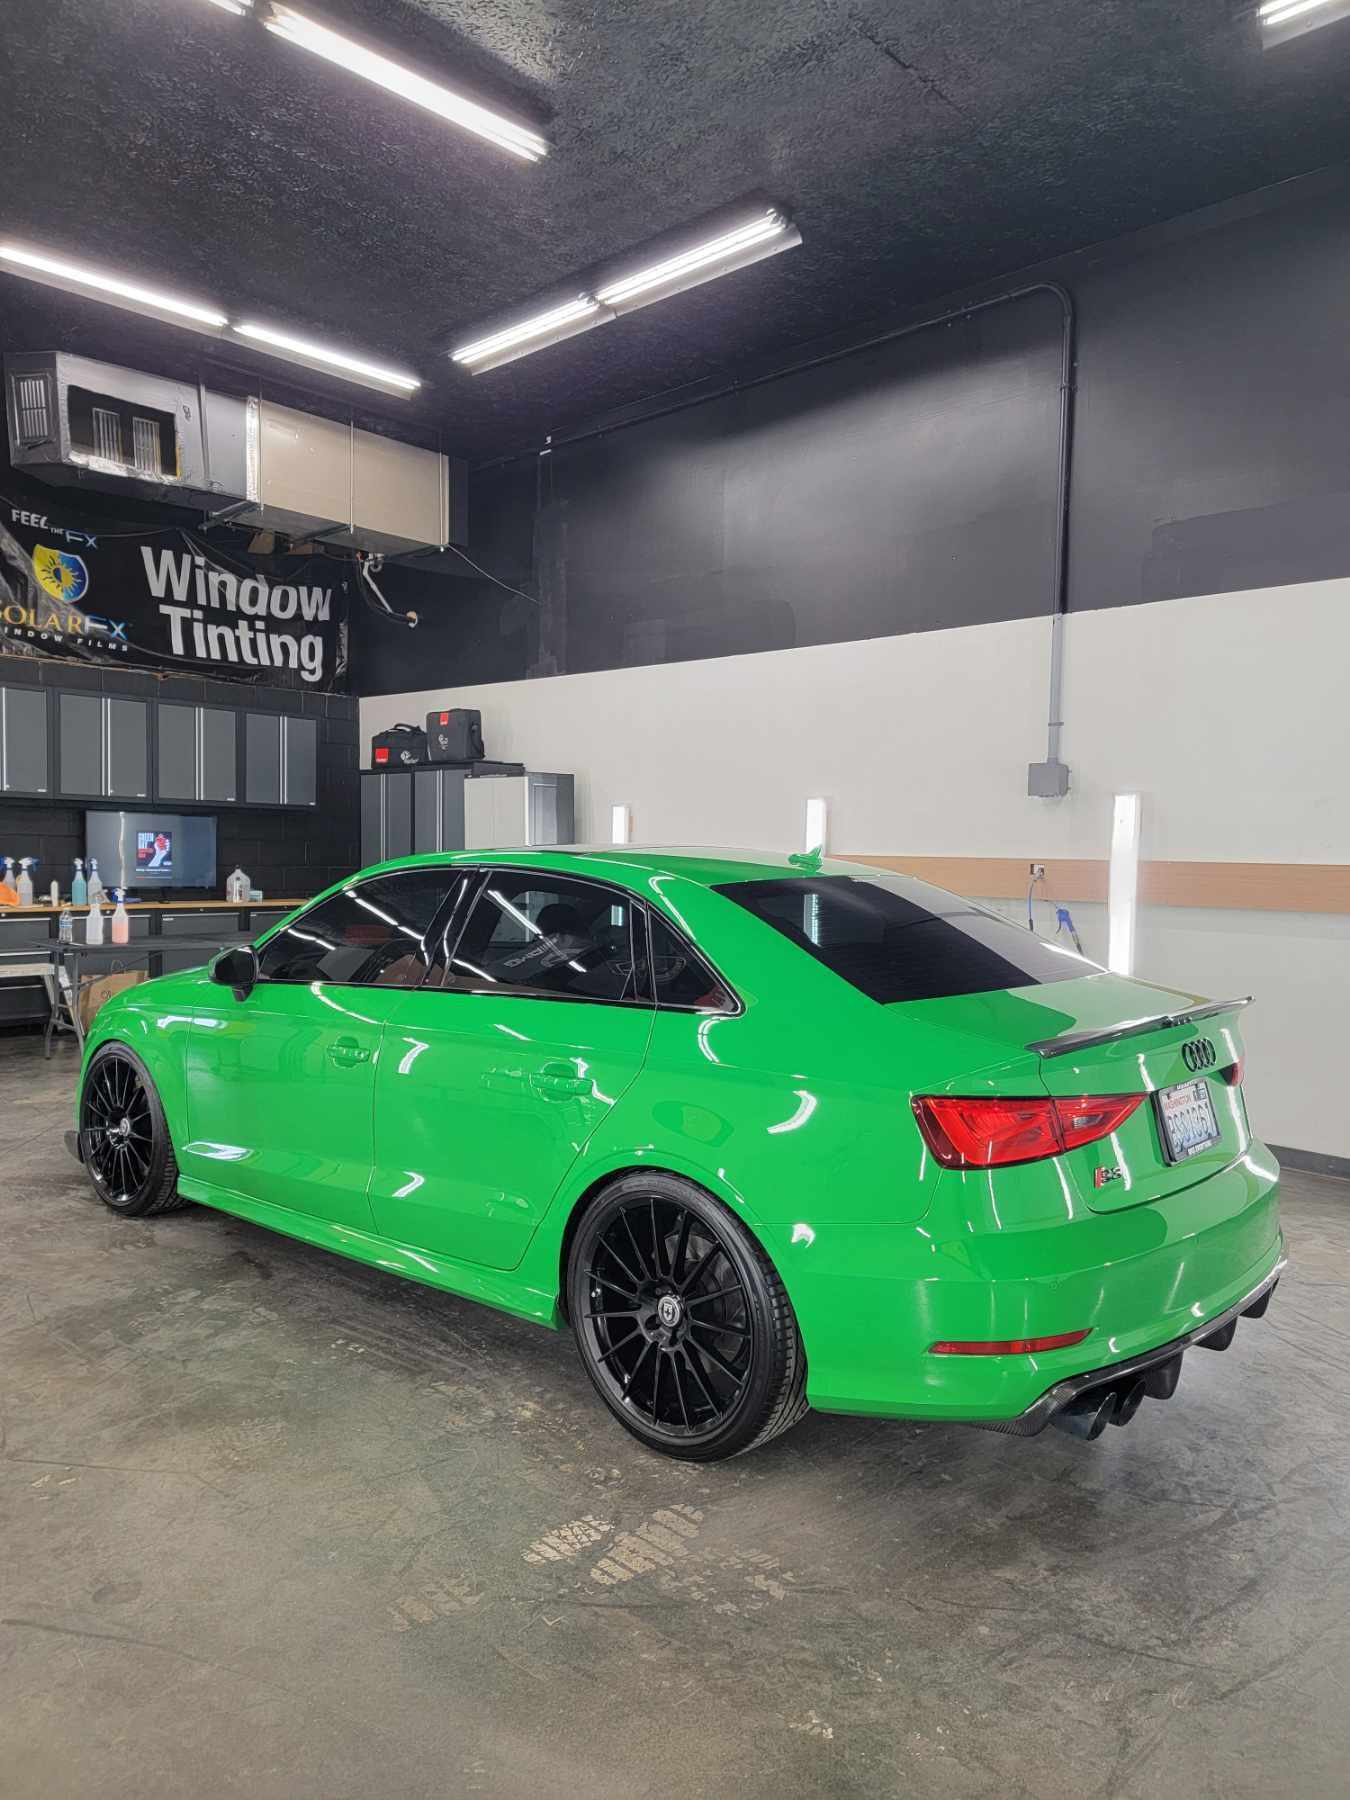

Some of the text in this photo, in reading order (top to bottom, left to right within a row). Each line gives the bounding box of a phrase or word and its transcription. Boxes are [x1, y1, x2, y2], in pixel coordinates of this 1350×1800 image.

[11, 509, 97, 549] FEEL THE FX
[140, 546, 331, 621] Window
[0, 605, 127, 640] OLARFX
[77, 638, 128, 652] FILMS
[159, 604, 323, 682] Tinting
